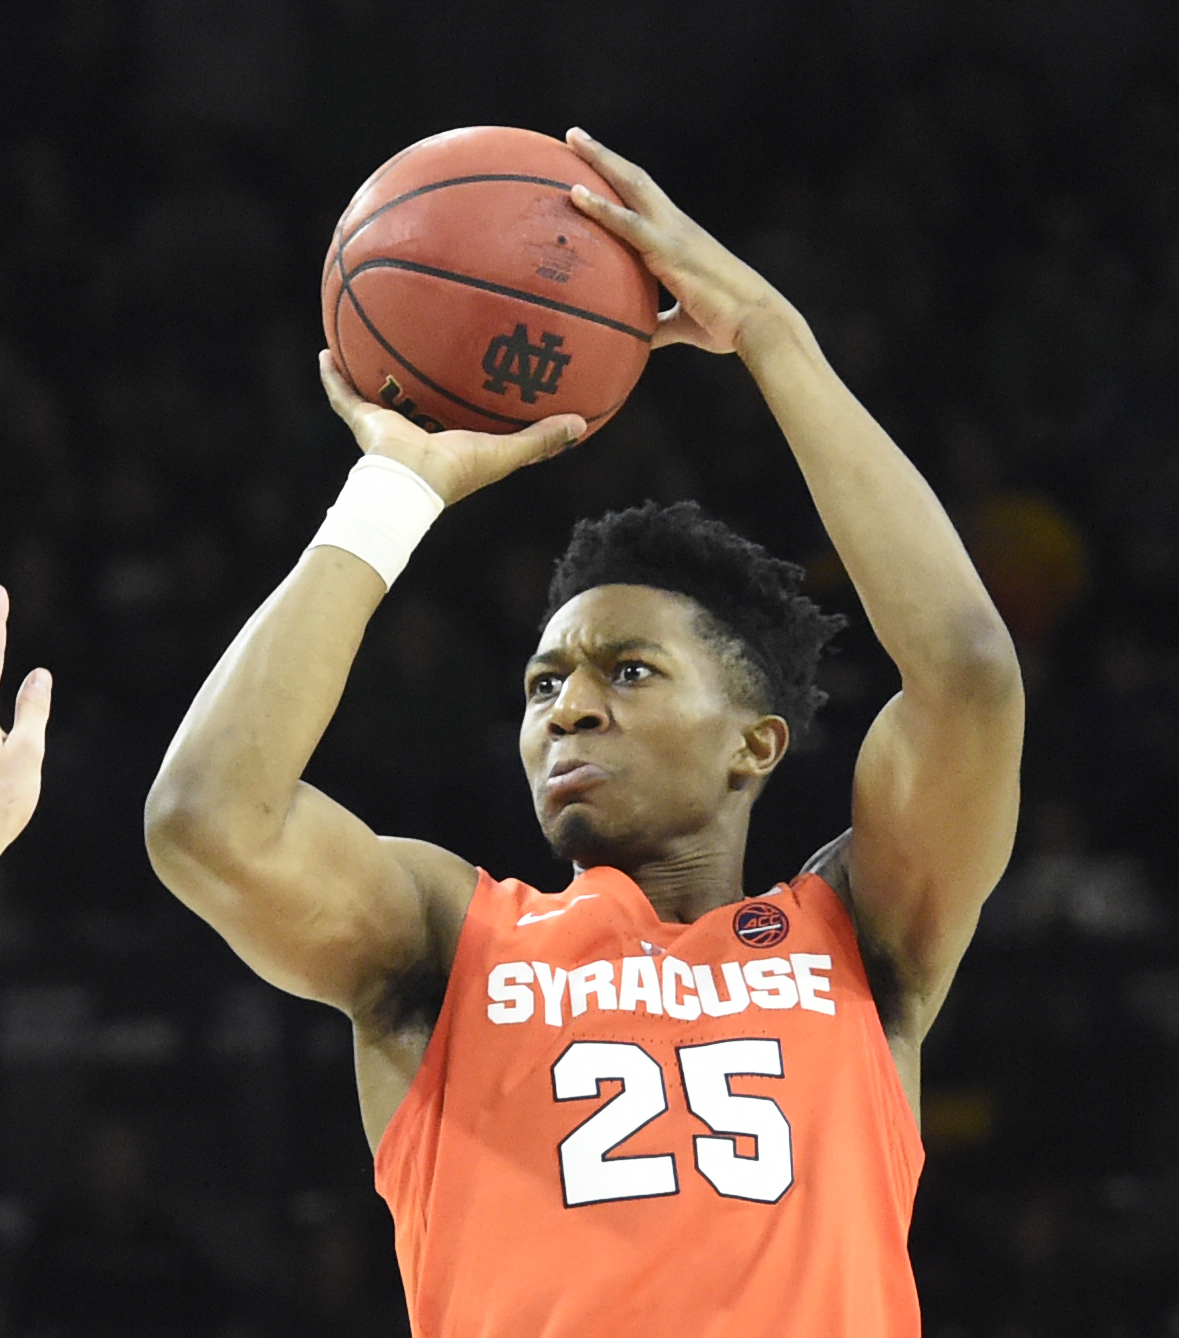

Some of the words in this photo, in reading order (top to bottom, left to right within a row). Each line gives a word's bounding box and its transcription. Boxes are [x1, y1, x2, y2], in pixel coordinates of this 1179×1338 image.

[743, 914, 781, 928] ACC
[487, 953, 836, 1027] SYRACUSE
[550, 1037, 794, 1209] 25
